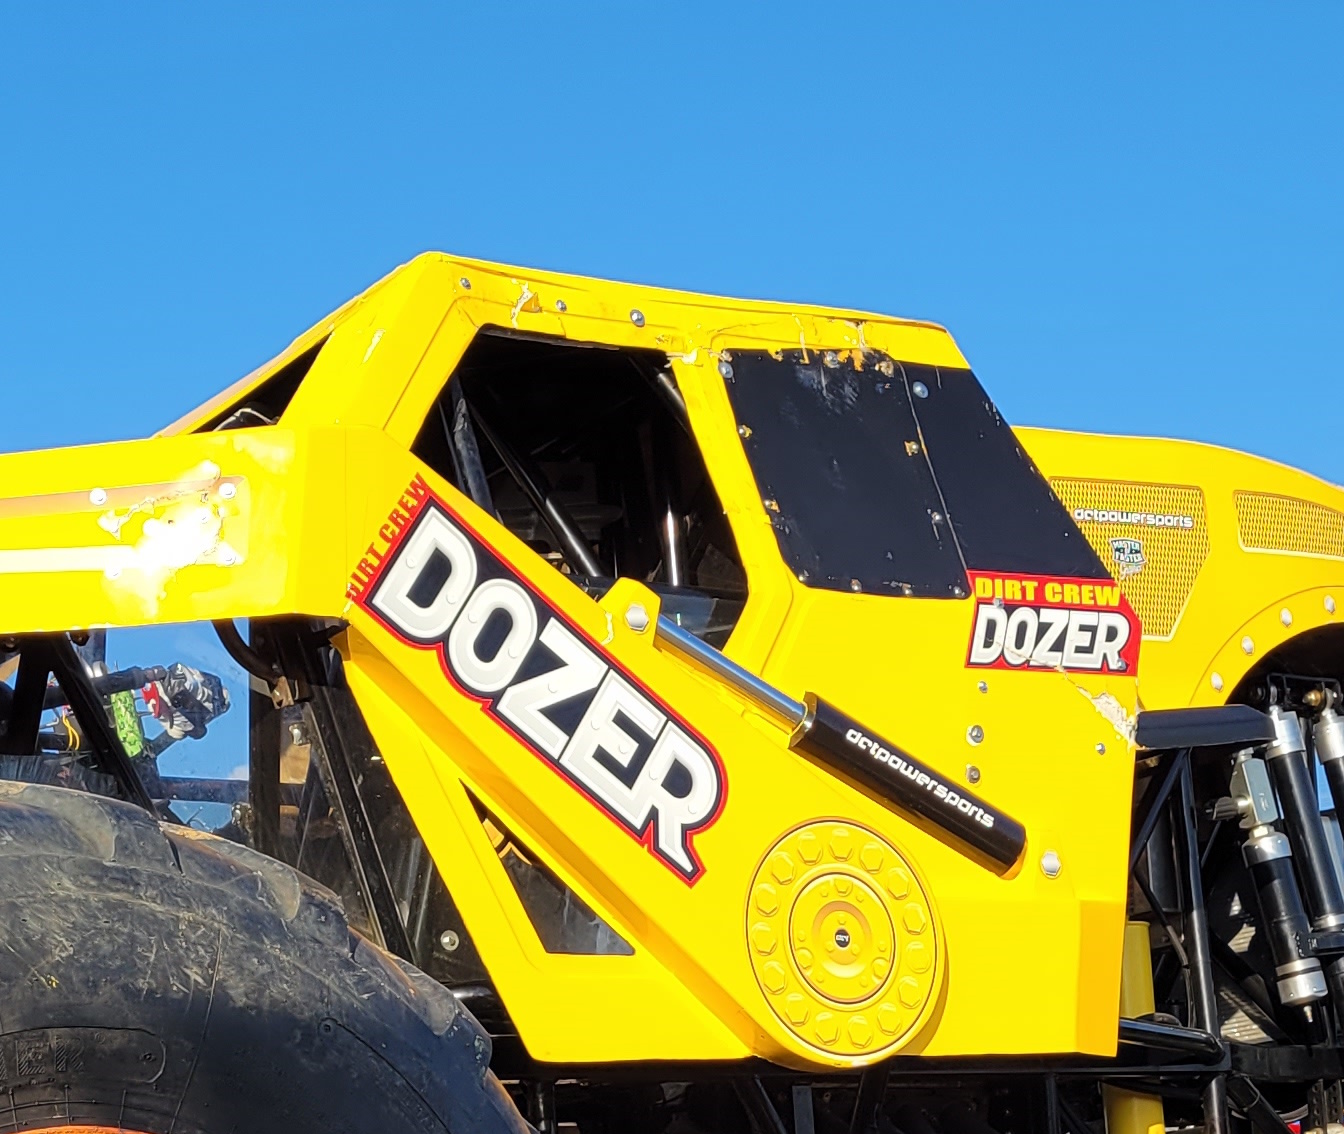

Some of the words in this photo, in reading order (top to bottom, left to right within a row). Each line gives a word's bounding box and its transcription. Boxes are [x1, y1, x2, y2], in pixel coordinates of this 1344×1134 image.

[377, 472, 431, 544] CREW
[974, 577, 1038, 600] DIRT
[1044, 582, 1121, 607] CREW
[969, 603, 1132, 670] DOZER
[372, 504, 720, 875] DOZER
